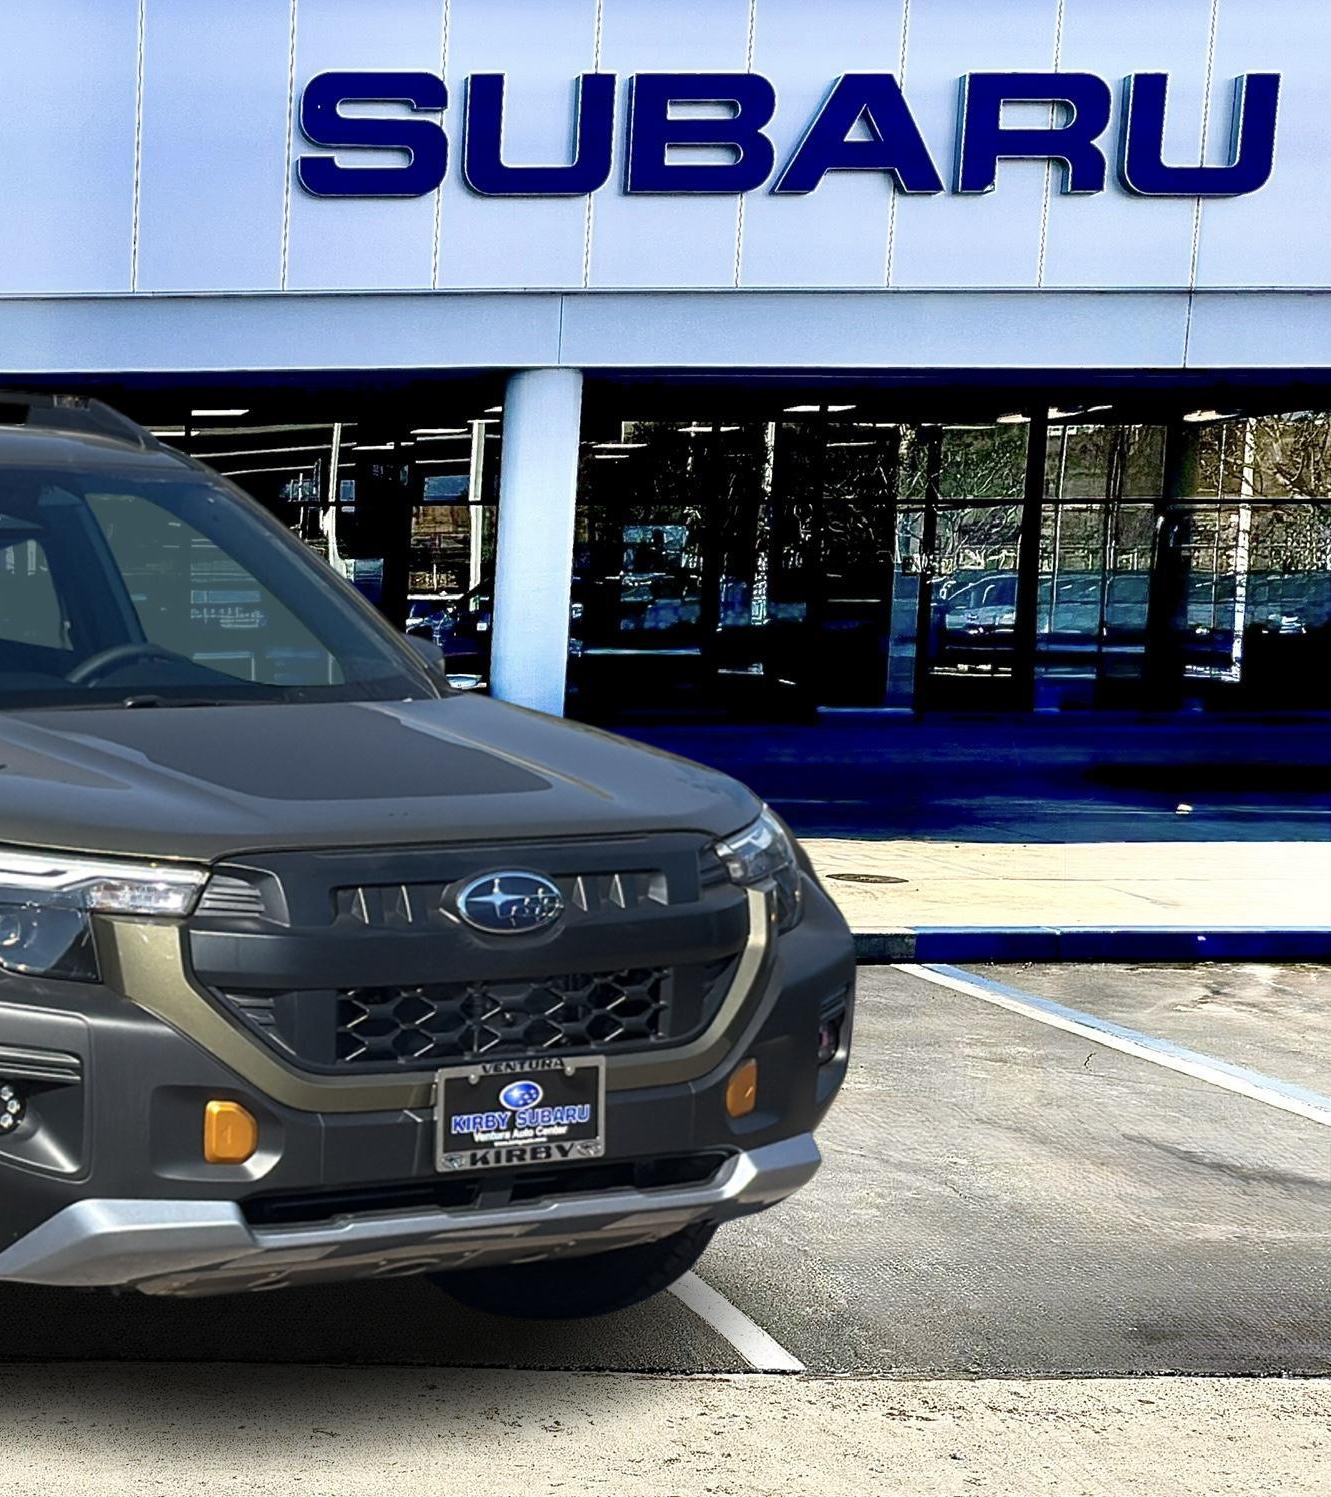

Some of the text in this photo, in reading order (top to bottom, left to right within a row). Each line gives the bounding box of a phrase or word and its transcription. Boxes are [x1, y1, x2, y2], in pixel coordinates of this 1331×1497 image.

[296, 71, 1282, 198] SUBARU
[482, 1058, 566, 1074] VENTURA
[451, 1104, 591, 1134] KIRBY SUBARU
[473, 1131, 511, 1143] Ventura
[512, 1127, 533, 1140] Auto
[535, 1125, 568, 1137] Center
[470, 1143, 575, 1168] KIRBY
